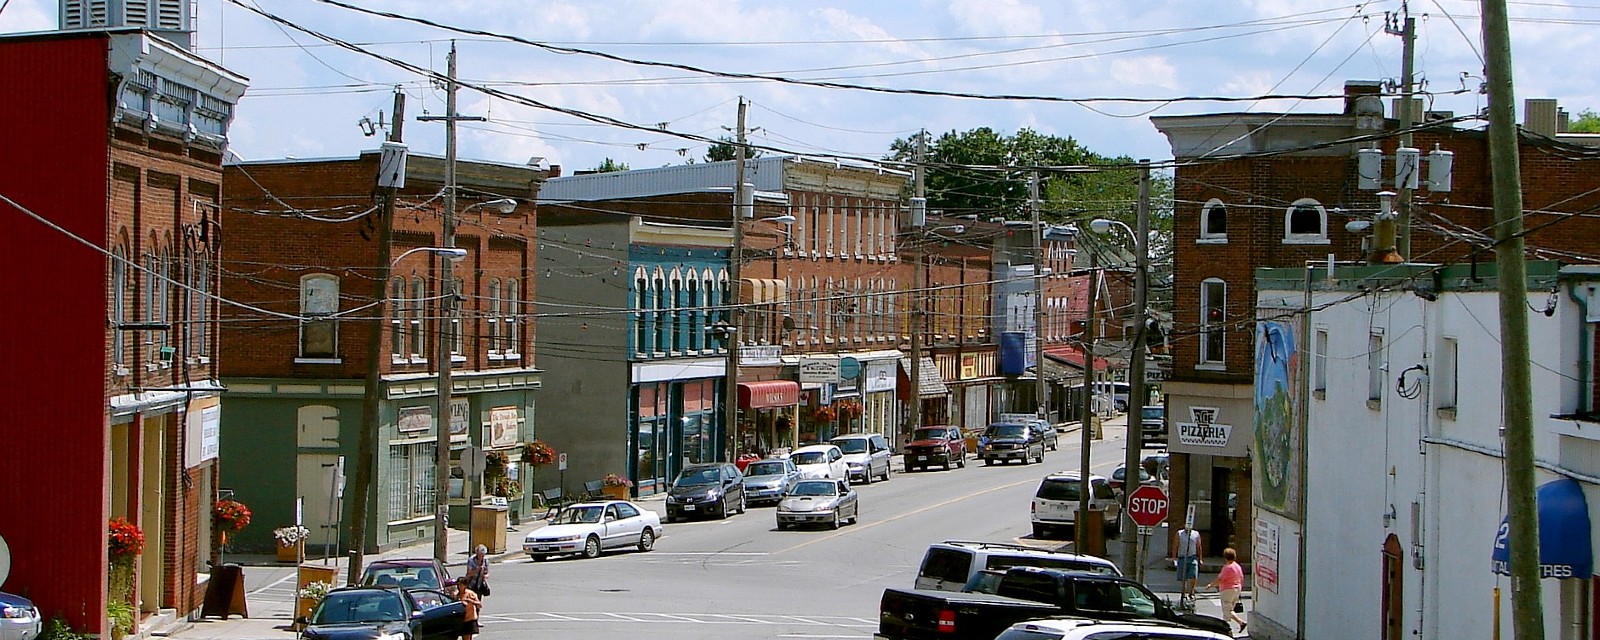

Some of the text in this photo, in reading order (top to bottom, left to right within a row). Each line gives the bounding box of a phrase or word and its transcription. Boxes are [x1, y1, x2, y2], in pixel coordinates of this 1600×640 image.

[1194, 411, 1214, 424] ACE
[1181, 425, 1226, 439] PIZZERIA
[1131, 497, 1167, 515] STOP
